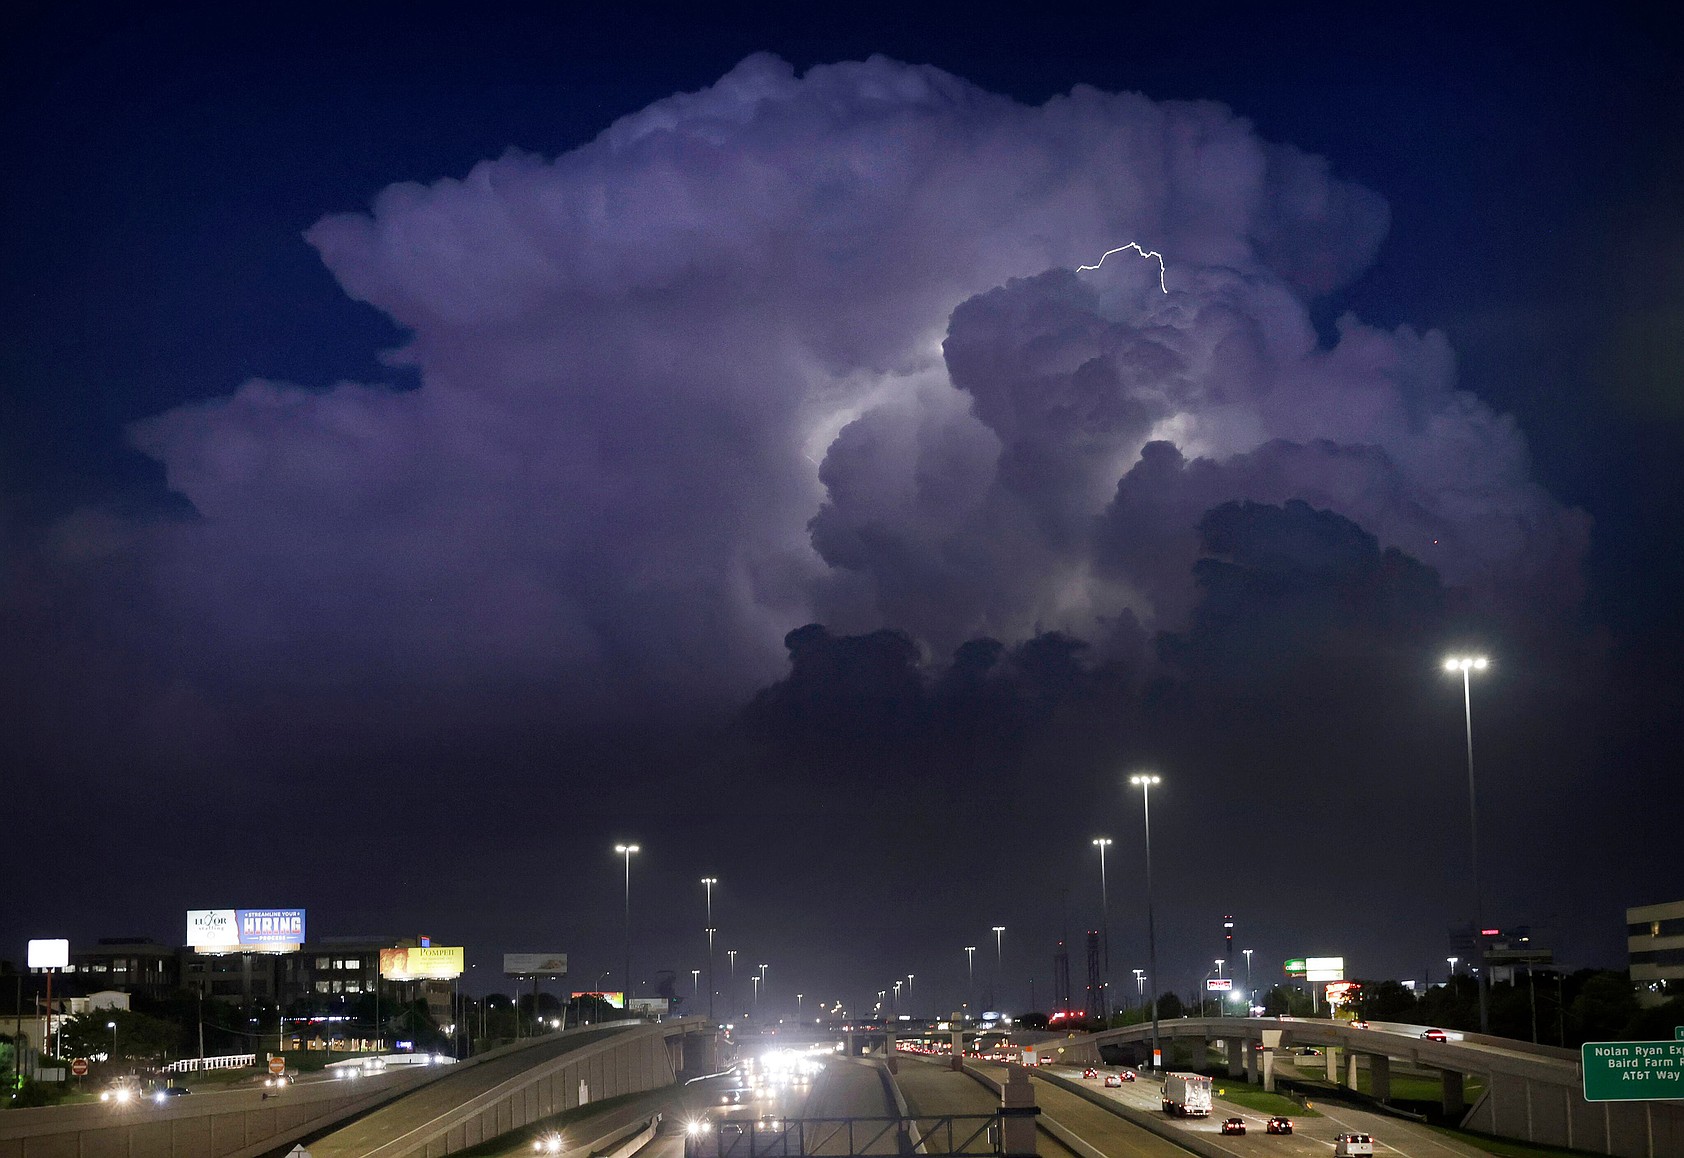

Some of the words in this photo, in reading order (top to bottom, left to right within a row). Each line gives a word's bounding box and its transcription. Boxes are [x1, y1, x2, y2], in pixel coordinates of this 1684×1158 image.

[244, 917, 301, 935] HIRING
[1595, 1047, 1629, 1056] Nolan
[1635, 1046, 1663, 1057] Ryan
[1608, 1058, 1639, 1068] Baird
[1645, 1058, 1673, 1067] Farm
[1622, 1071, 1651, 1080] AT&T
[1656, 1070, 1681, 1081] Way
